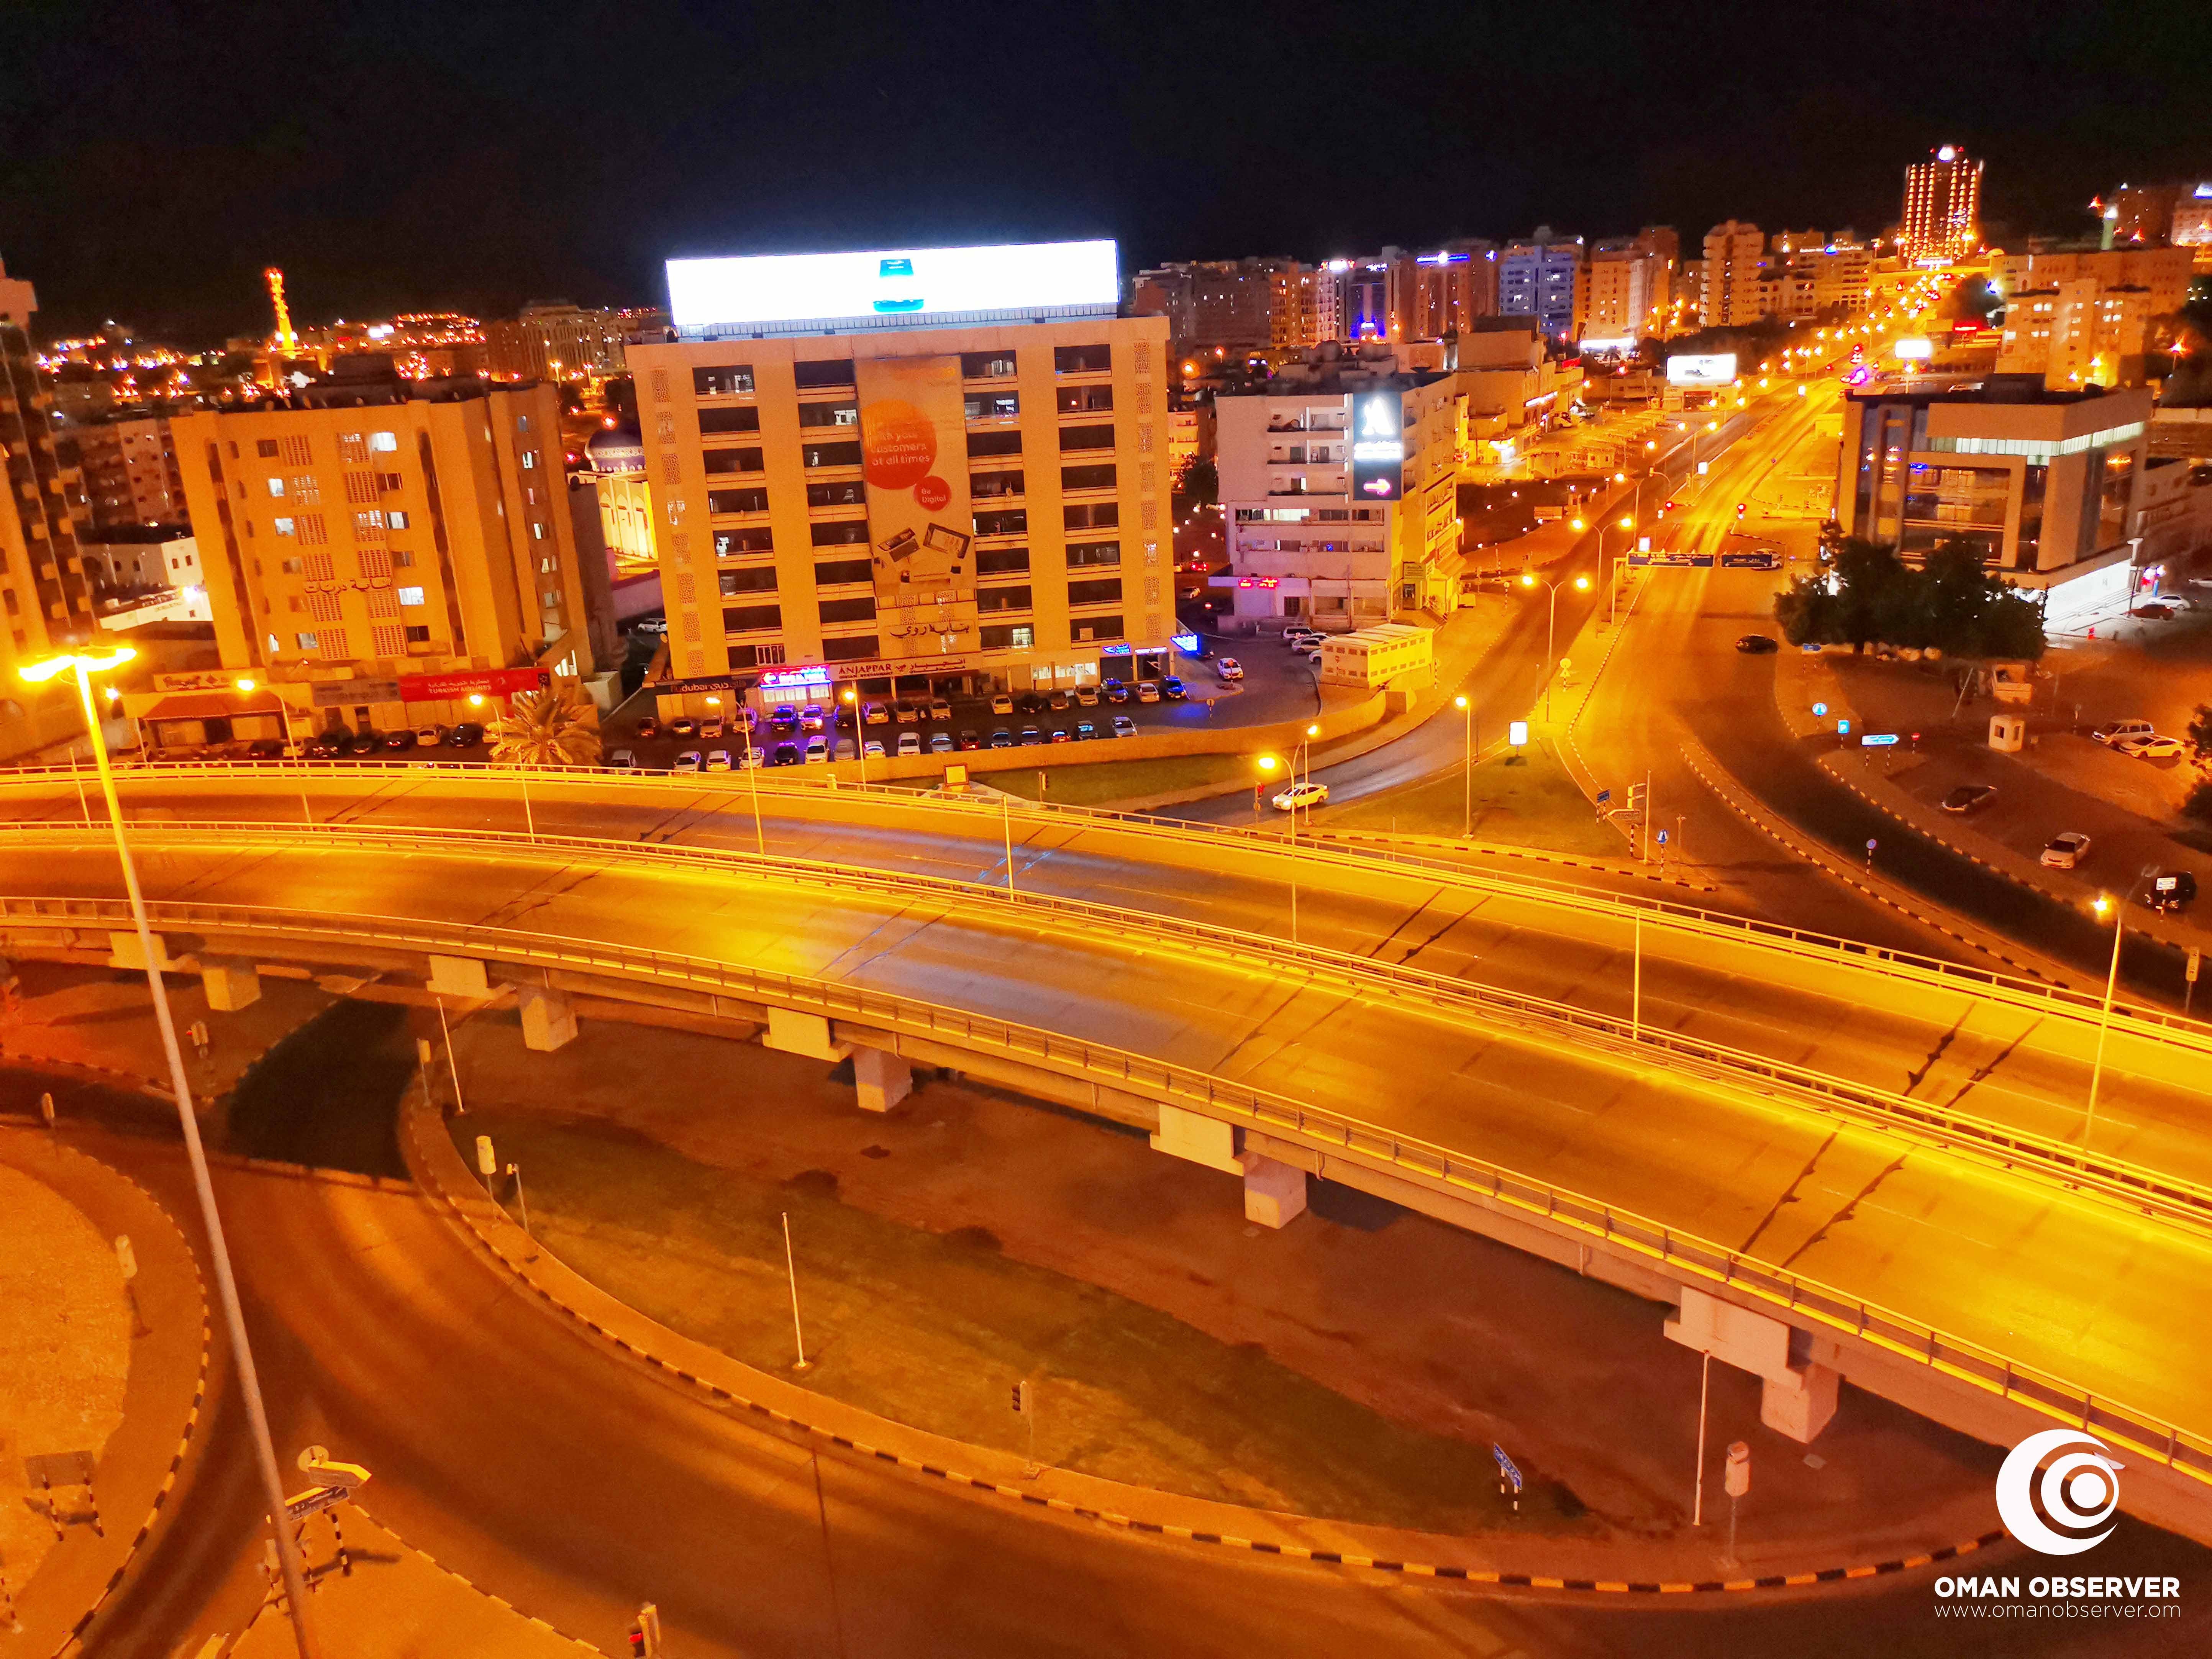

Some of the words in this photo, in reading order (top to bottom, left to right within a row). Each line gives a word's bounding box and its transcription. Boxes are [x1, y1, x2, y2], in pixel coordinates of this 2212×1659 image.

[871, 443, 927, 453] customers
[872, 457, 883, 466] at
[886, 455, 899, 465] all
[900, 454, 930, 464] times
[922, 496, 946, 504] Digital
[889, 625, 927, 639] روي
[838, 663, 892, 675] ANJAPPAR
